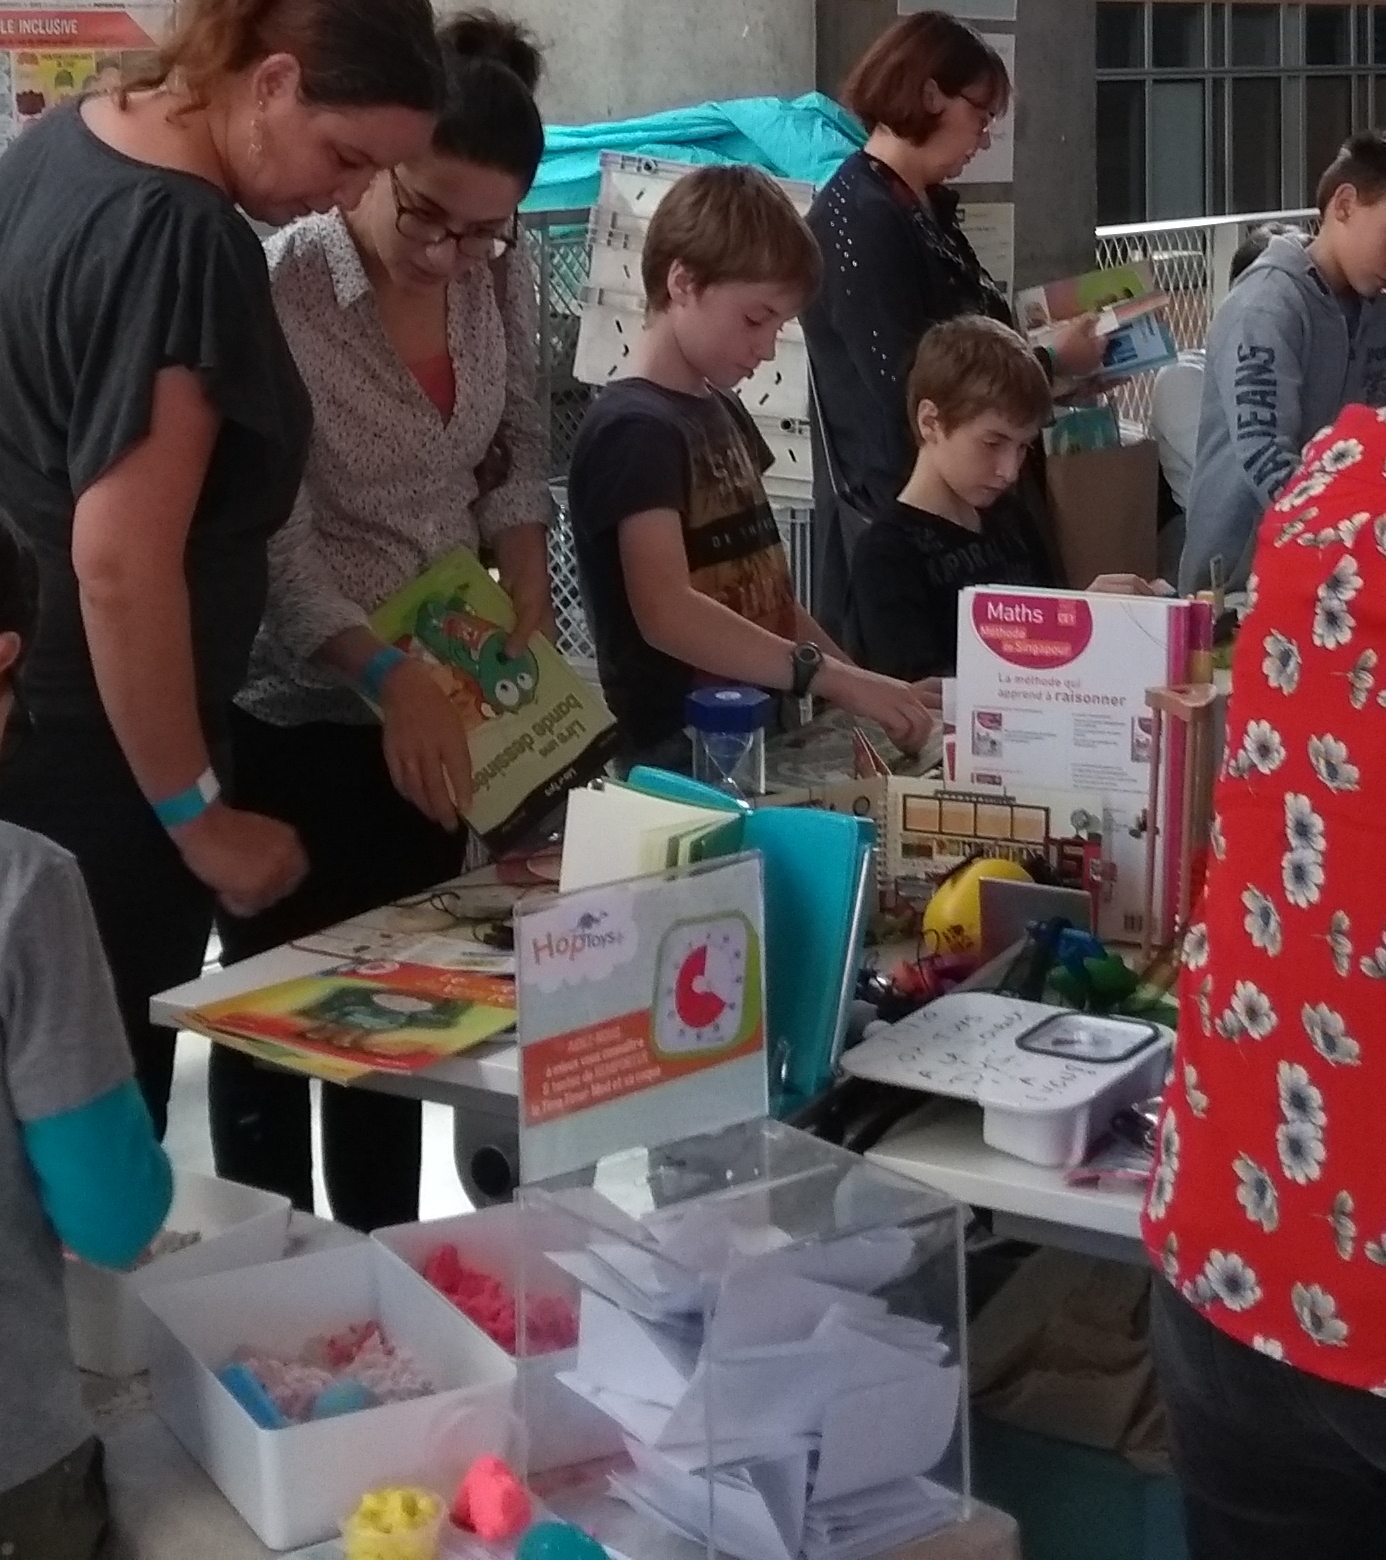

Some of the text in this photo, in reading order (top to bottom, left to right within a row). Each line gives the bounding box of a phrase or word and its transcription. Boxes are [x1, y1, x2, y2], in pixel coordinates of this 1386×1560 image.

[19, 19, 79, 36] INCLUSIVE
[1234, 342, 1278, 441] JEANS
[987, 602, 1044, 624] Maths
[999, 672, 1011, 683] La
[1064, 676, 1082, 690] qui
[998, 689, 1042, 702] apprend
[1055, 690, 1127, 707] raisonner
[531, 692, 584, 739] bande
